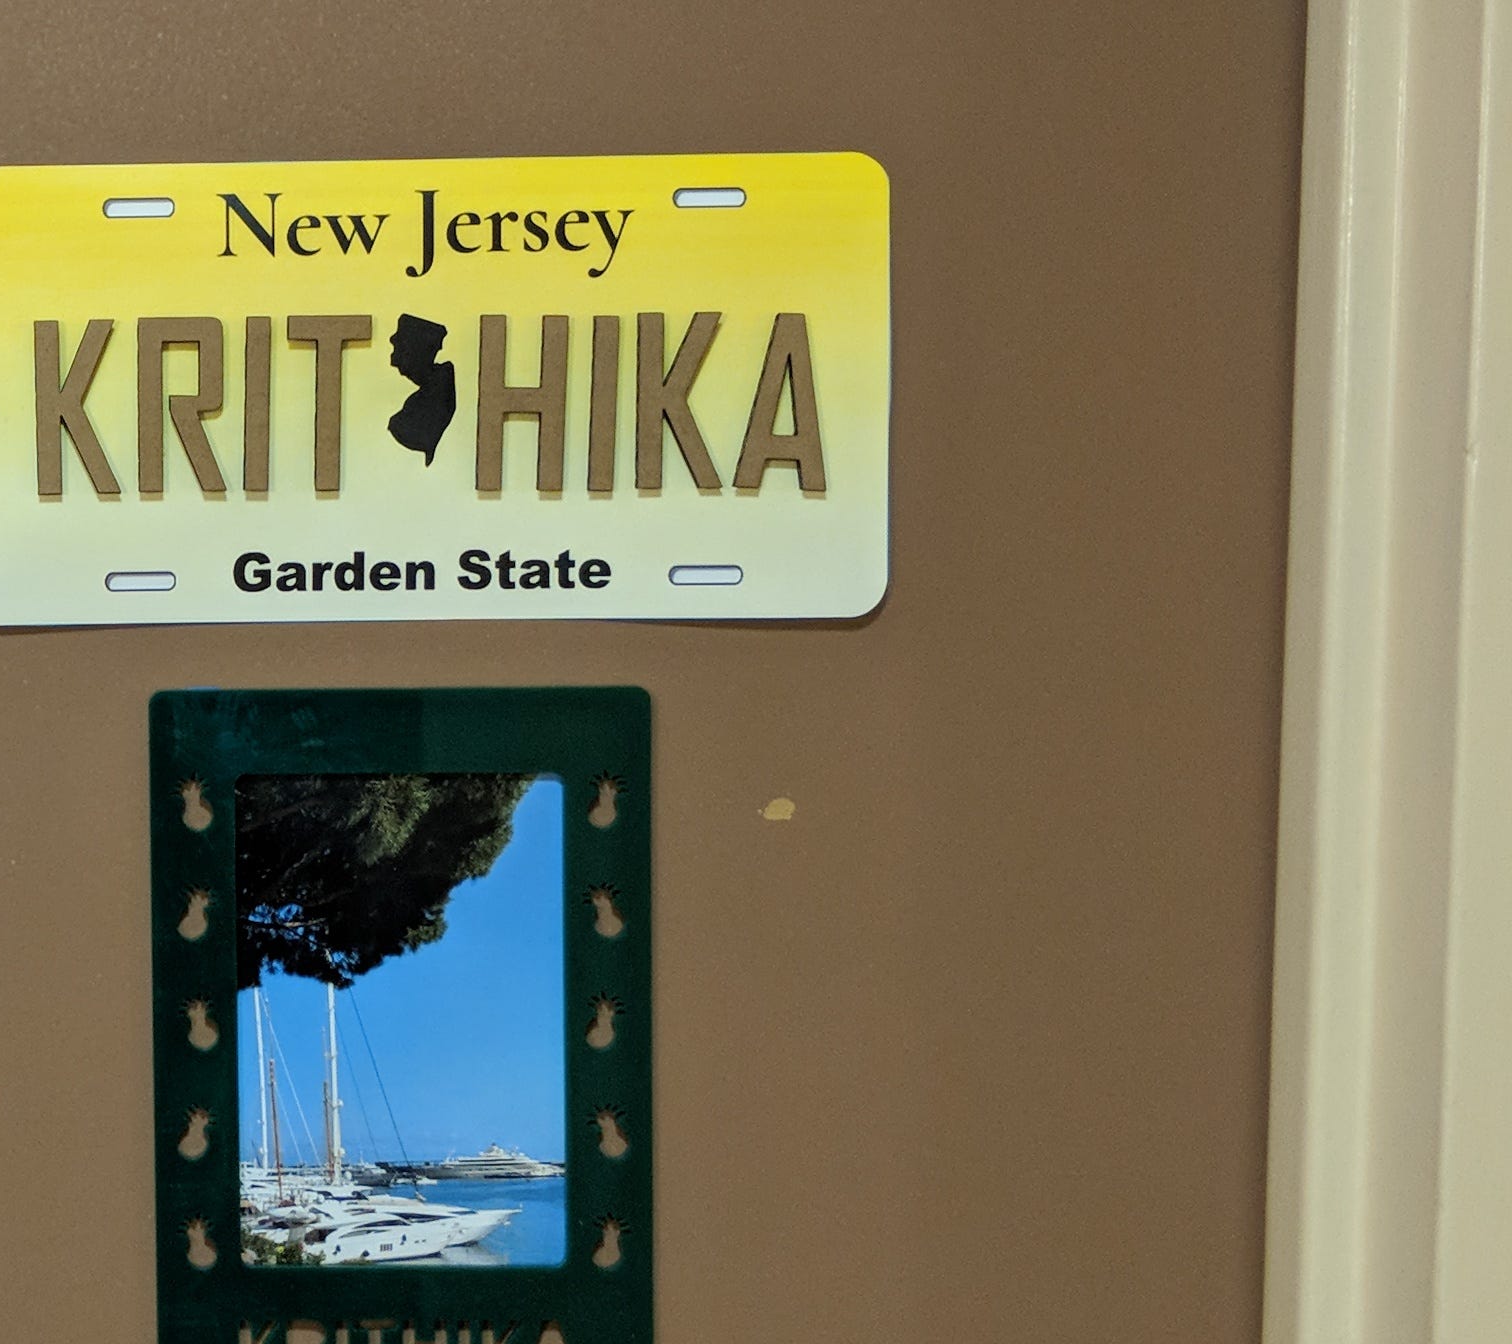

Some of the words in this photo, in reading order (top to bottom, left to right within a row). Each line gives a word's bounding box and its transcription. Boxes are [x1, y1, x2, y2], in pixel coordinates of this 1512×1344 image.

[217, 192, 390, 259] New
[405, 188, 635, 278] Jersey
[232, 551, 437, 594] Garden
[457, 548, 612, 591] State
